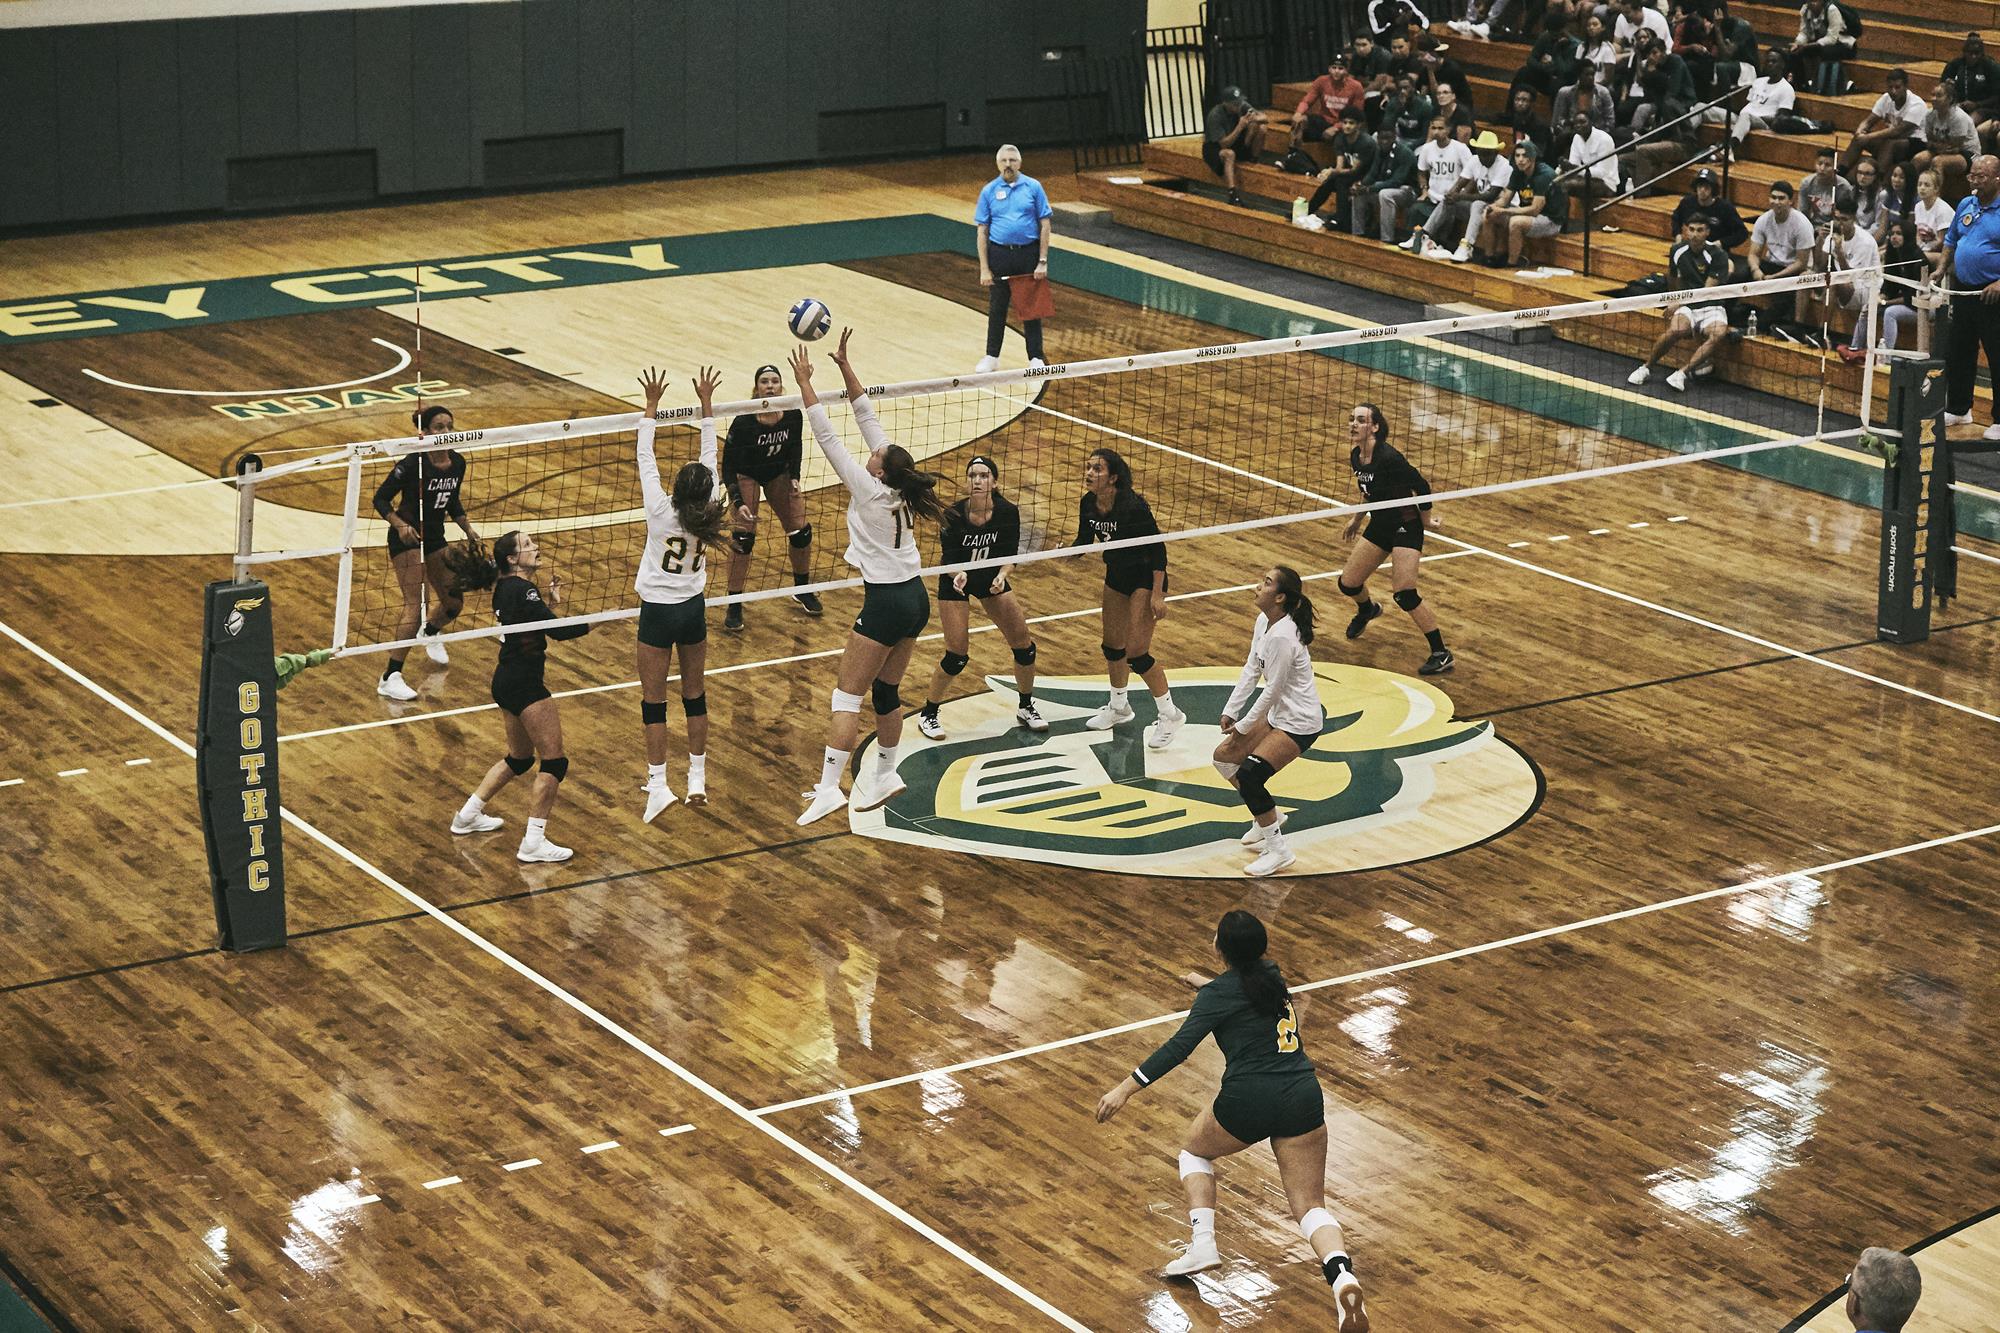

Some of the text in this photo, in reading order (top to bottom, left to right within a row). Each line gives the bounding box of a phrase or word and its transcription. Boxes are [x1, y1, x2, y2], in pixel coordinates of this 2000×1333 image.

[270, 243, 680, 303] CITY
[1514, 309, 1550, 320] JERSEY CITY
[1360, 326, 1398, 338] JERSEY CITY
[1196, 345, 1237, 358] JERSEY CITY
[1023, 365, 1066, 378] JERSEY CITY
[869, 385, 885, 396] CITY
[211, 380, 471, 421] NJAC
[676, 406, 693, 418] CITY
[433, 430, 484, 446] JERSEY CITY
[757, 428, 790, 446] CAIRN
[428, 477, 459, 491] CAIRN
[434, 492, 451, 509] 15
[1912, 418, 1936, 610] KNIGHTS
[962, 531, 999, 547] CAIRN
[1887, 525, 1897, 592] sports imports
[238, 681, 270, 892] GOTHIC
[1276, 999, 1299, 1053] 2
